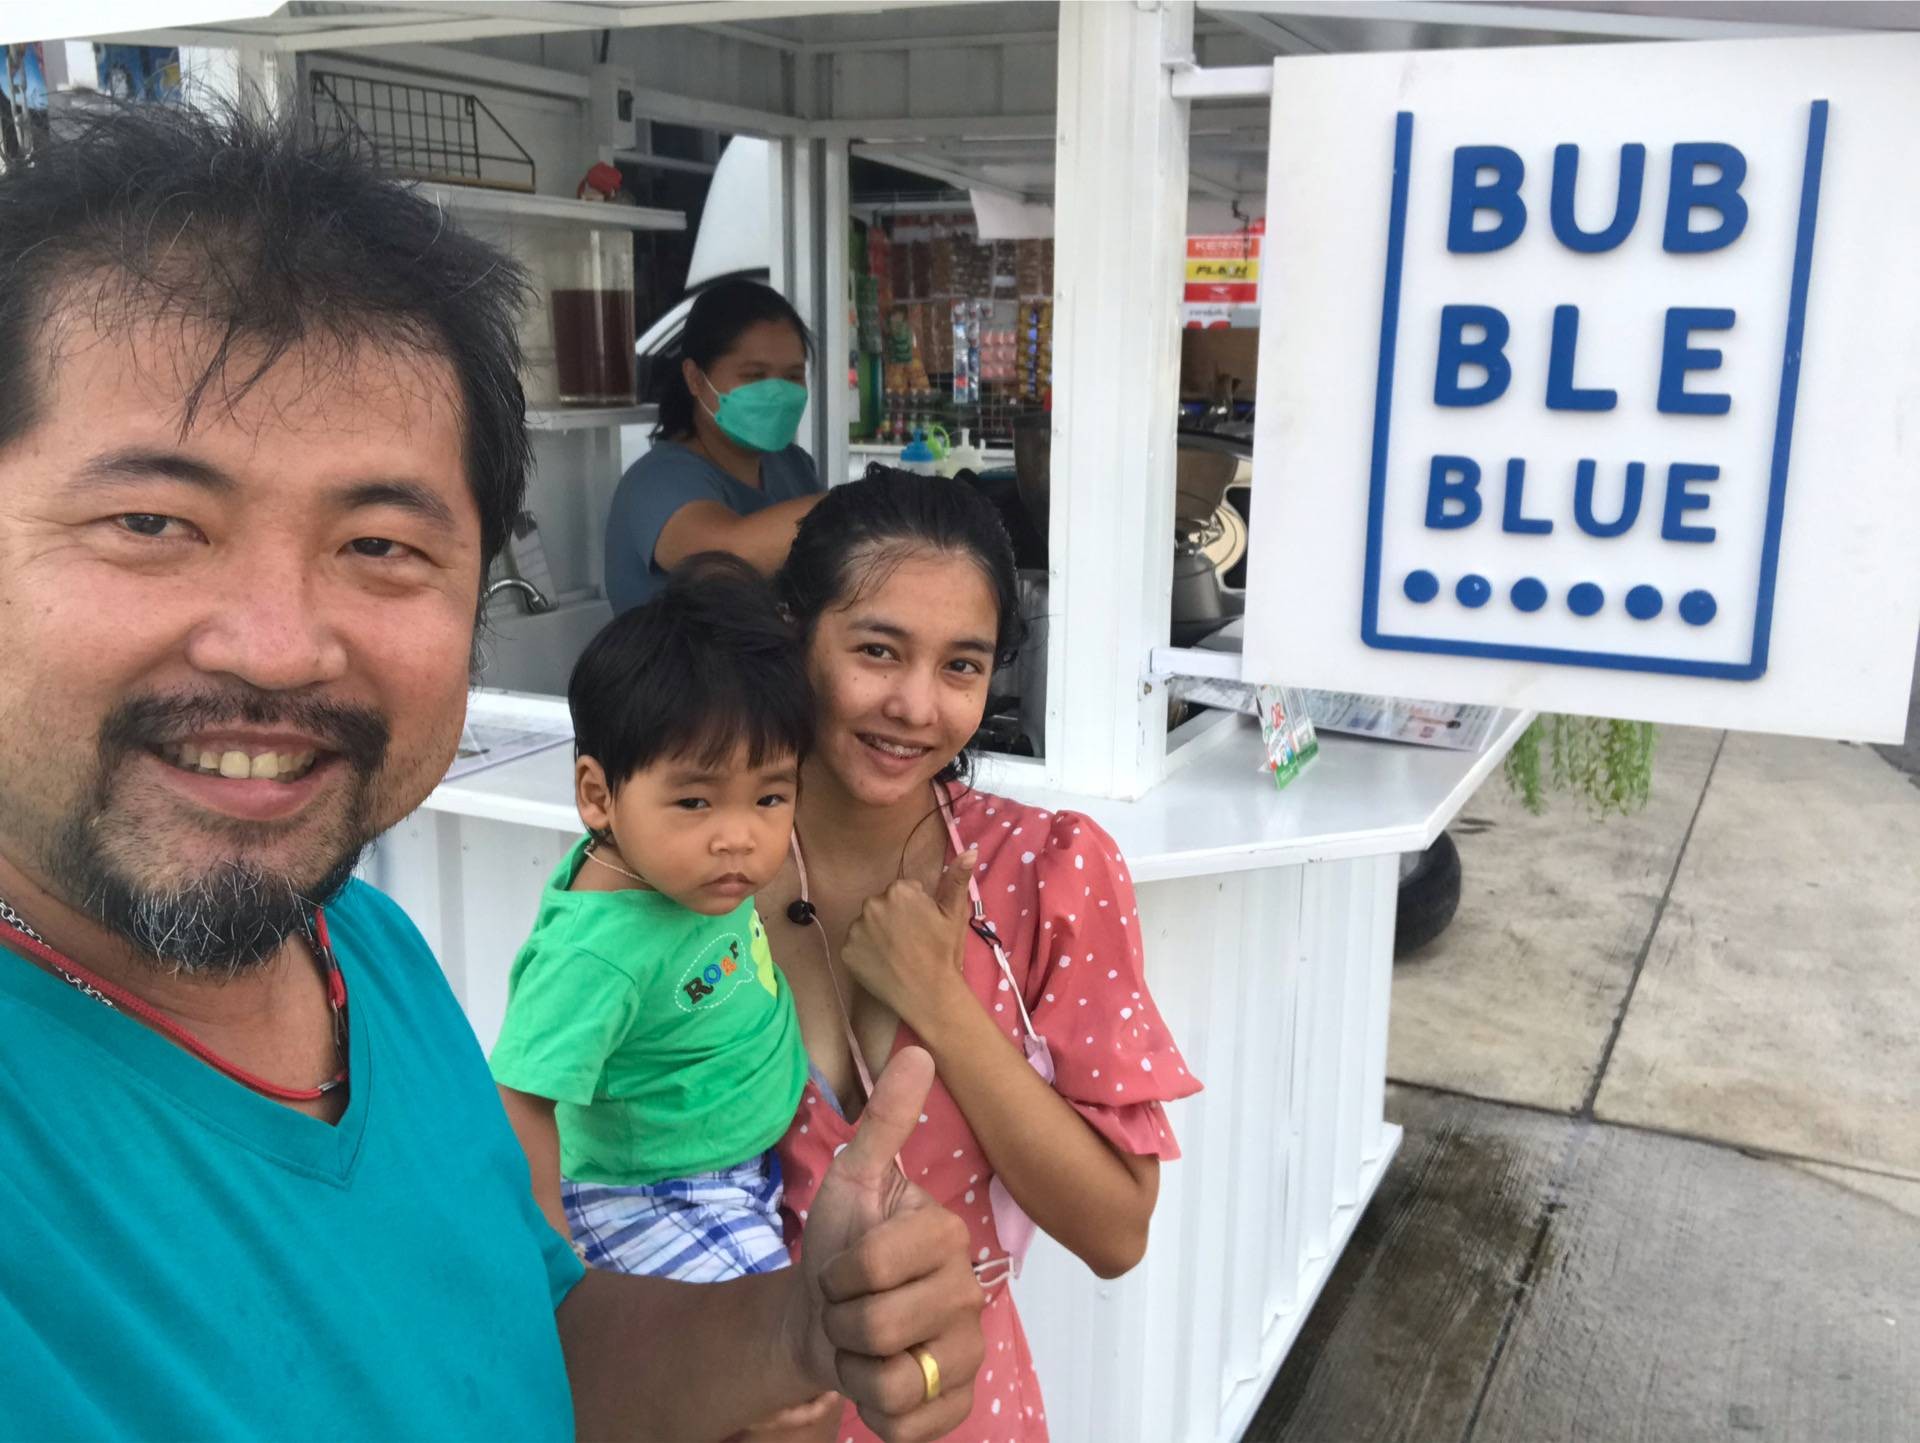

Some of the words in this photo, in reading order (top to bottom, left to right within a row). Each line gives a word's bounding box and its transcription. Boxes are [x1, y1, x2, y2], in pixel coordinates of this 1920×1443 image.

[1447, 142, 1749, 254] BUB
[1433, 303, 1737, 415] BLE
[1424, 454, 1721, 543] BLUE
